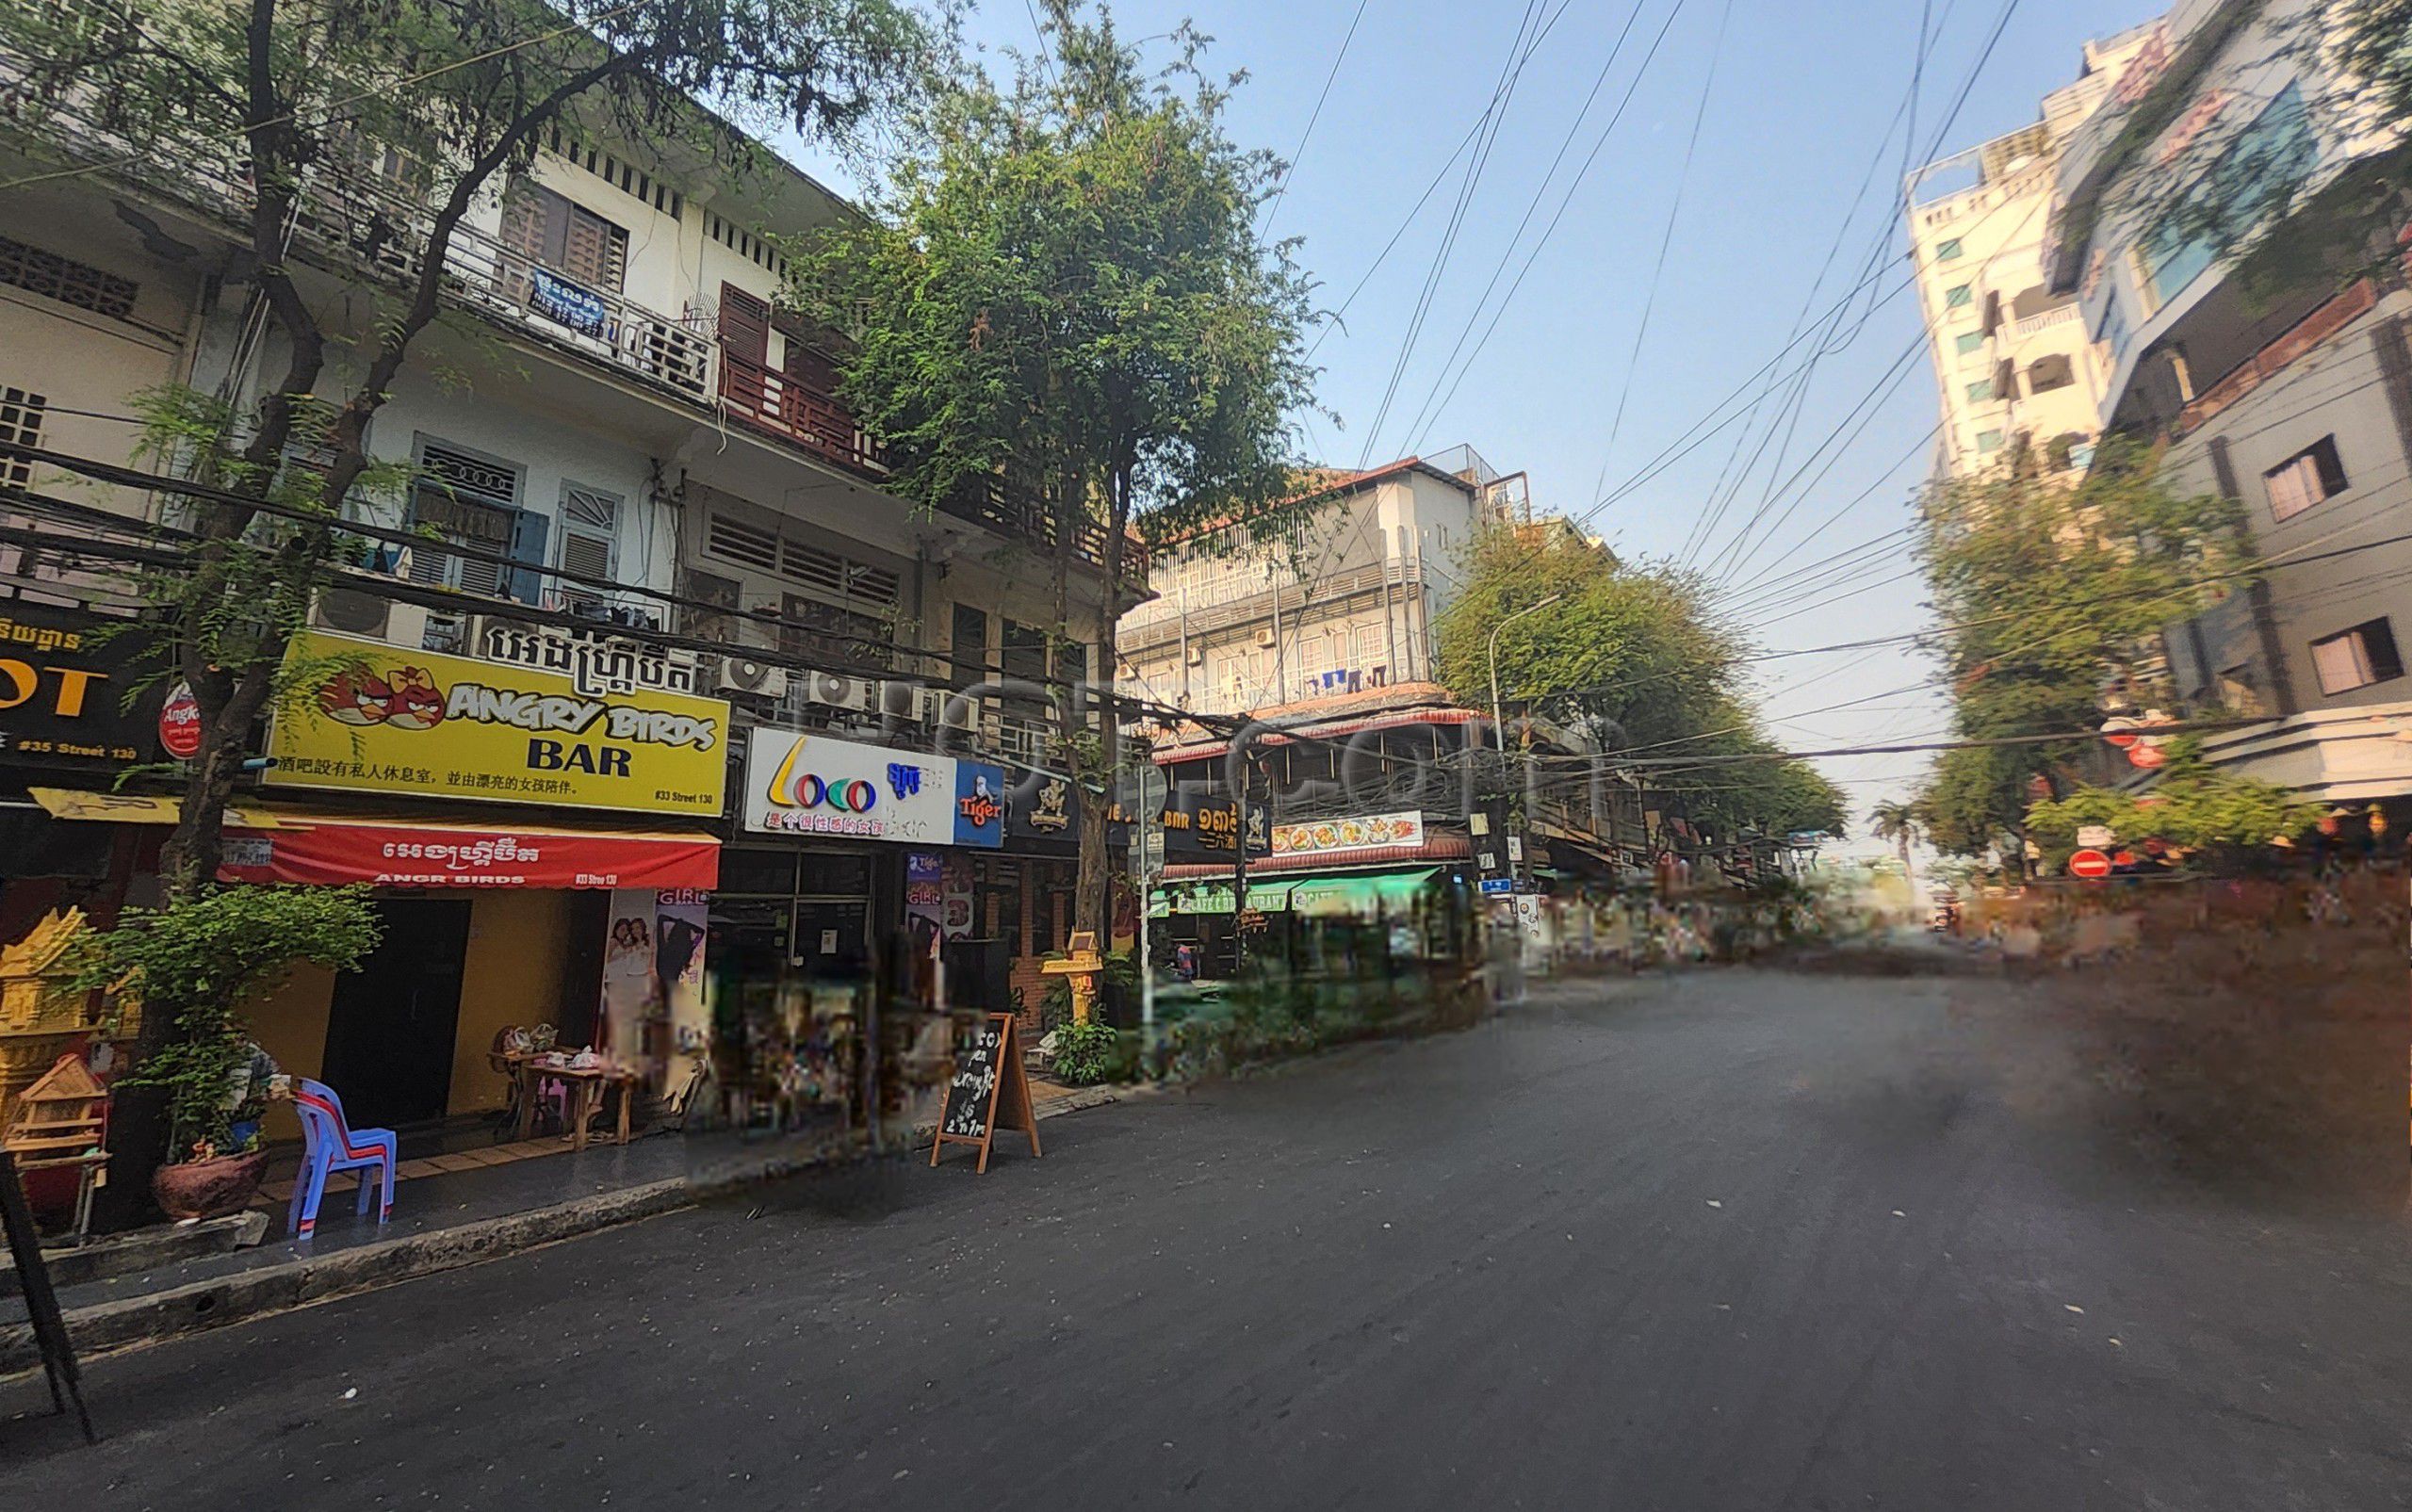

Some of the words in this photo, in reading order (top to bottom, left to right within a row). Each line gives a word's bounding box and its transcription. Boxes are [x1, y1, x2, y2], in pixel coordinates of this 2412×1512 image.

[163, 705, 200, 725] Angk
[444, 684, 606, 734] ANGRY
[606, 707, 716, 751] BIRDS
[19, 740, 52, 752] #35
[57, 743, 105, 756] Street
[112, 747, 137, 759] 130
[526, 738, 632, 777] BAR
[655, 789, 670, 801] #33
[672, 791, 696, 804] Street
[699, 793, 713, 805] 130
[959, 796, 1002, 825] Tiger
[374, 873, 447, 884] ANGR
[455, 874, 526, 885] BIRDS
[660, 888, 704, 904] GIRL
[909, 891, 939, 904] GIRL
